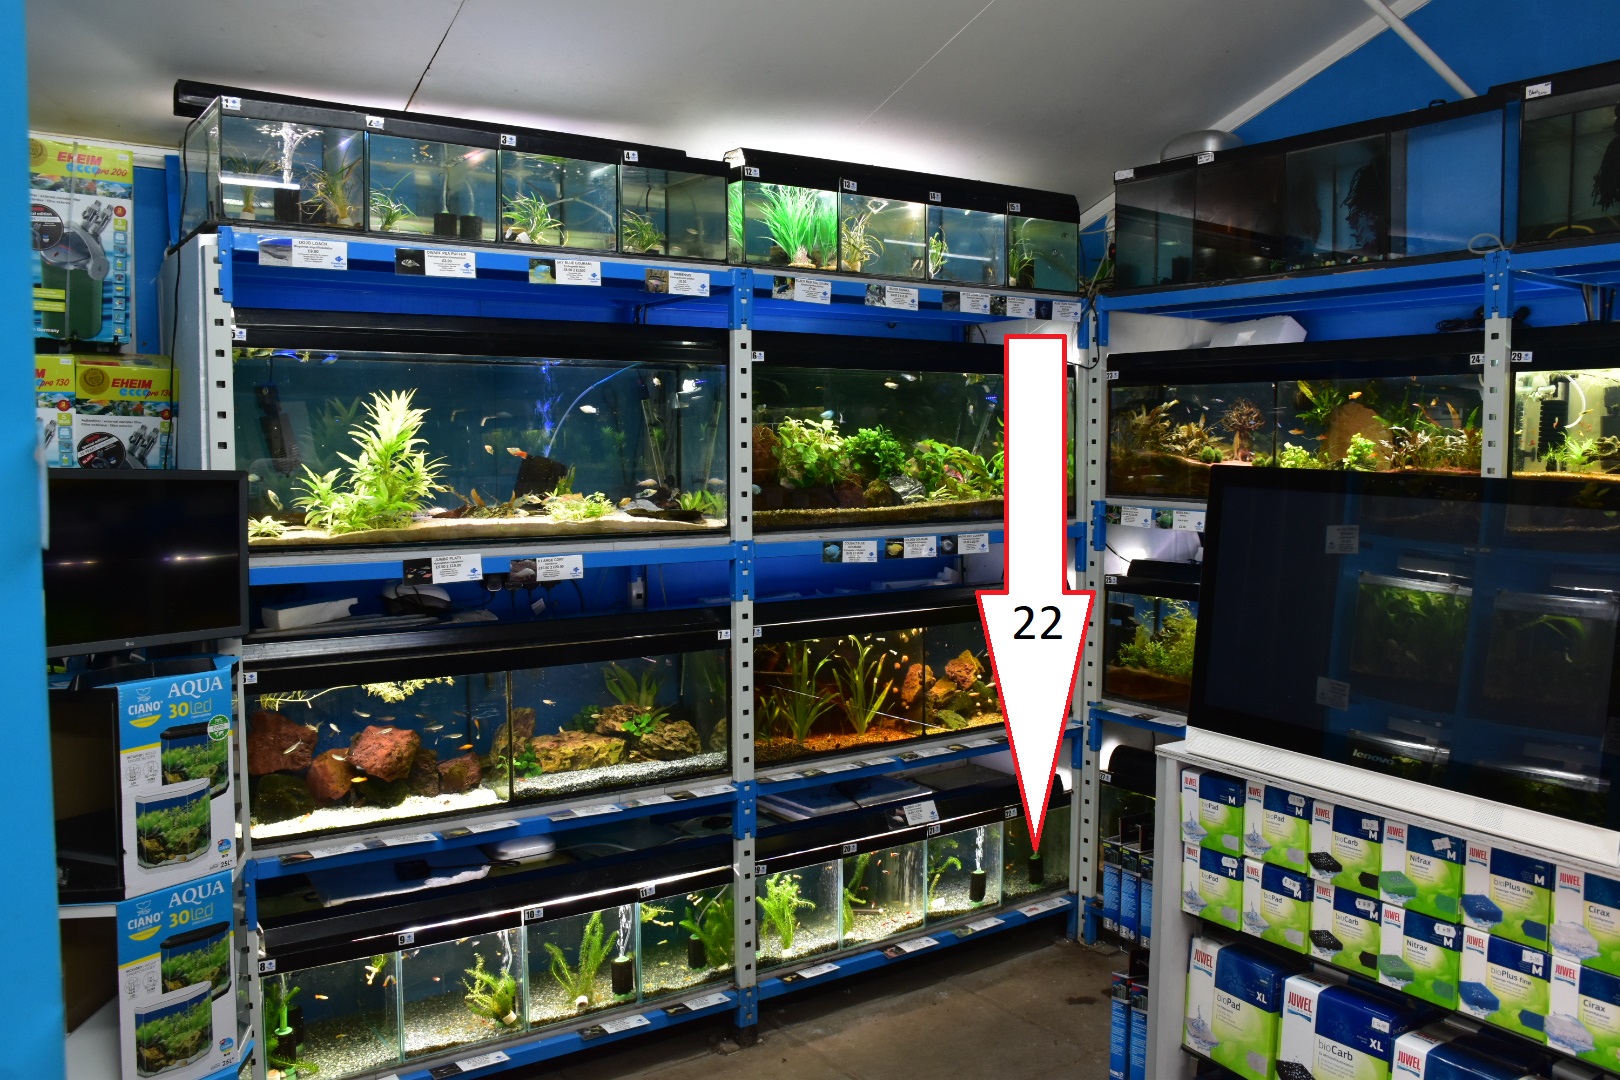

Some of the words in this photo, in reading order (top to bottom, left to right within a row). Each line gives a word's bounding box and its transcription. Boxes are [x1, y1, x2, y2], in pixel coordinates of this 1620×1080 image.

[502, 136, 506, 144] 3
[57, 152, 102, 166] EHEIM
[626, 152, 630, 160] 4
[94, 168, 109, 177] pro
[111, 168, 127, 177] 200
[1471, 355, 1480, 363] 24
[39, 379, 53, 389] pro
[56, 378, 69, 386] 130
[111, 378, 152, 389] EHEIM
[120, 388, 147, 397] ecco
[145, 390, 159, 399] pro
[168, 676, 223, 698] AQUA
[128, 701, 160, 716] CIANO
[1352, 749, 1395, 765] lenovo
[1184, 777, 1197, 787] JUWEL
[1248, 787, 1262, 798] JUWEL
[1229, 795, 1235, 805] M
[1202, 802, 1219, 811] bioPad
[1295, 807, 1303, 816] M
[1266, 812, 1285, 822] bioPad
[1315, 807, 1330, 819] JUWEL
[1369, 830, 1377, 840] M
[1387, 826, 1404, 838] JUWEL
[1335, 835, 1359, 847] bioCarb
[1186, 847, 1198, 858] JUWEL
[1447, 850, 1456, 861] M
[1469, 847, 1488, 861] JUWEL
[1410, 854, 1432, 866] Nitrax
[1202, 872, 1219, 883] bioPad
[1229, 868, 1236, 878] M
[1246, 866, 1260, 877] JUWEL
[1534, 874, 1545, 886] M
[1559, 872, 1580, 886] JUWEL
[641, 889, 647, 897] 11
[1316, 885, 1331, 897] JUWEL
[1494, 878, 1521, 892] bioPlus
[1522, 887, 1534, 896] fine
[168, 880, 225, 908] AQUA
[1264, 892, 1283, 904] bioPad
[1294, 890, 1302, 899] M
[526, 911, 534, 919] 10
[1370, 911, 1378, 921] M
[1384, 909, 1401, 922] JUWEL
[1588, 906, 1610, 918] Cirax
[128, 912, 161, 930] CIANO
[1336, 913, 1359, 926] bioCarb
[400, 936, 405, 944] 9
[1407, 940, 1428, 952] Nitrax
[1443, 936, 1453, 948] M
[1466, 935, 1485, 949] JUWEL
[1194, 948, 1213, 968] JUWEL
[260, 963, 265, 971] 8
[1532, 964, 1543, 977] M
[1555, 964, 1576, 980] JUWEL
[1491, 967, 1518, 981] bioPlus
[1519, 977, 1532, 986] fine
[1217, 994, 1240, 1011] bioPad
[1256, 991, 1267, 1004] XL
[1288, 991, 1312, 1013] JUWEL
[1583, 999, 1606, 1013] Cirax
[1318, 1038, 1353, 1061] bioCarb
[1369, 1037, 1384, 1052] XL
[1398, 1050, 1420, 1071] JUWEL
